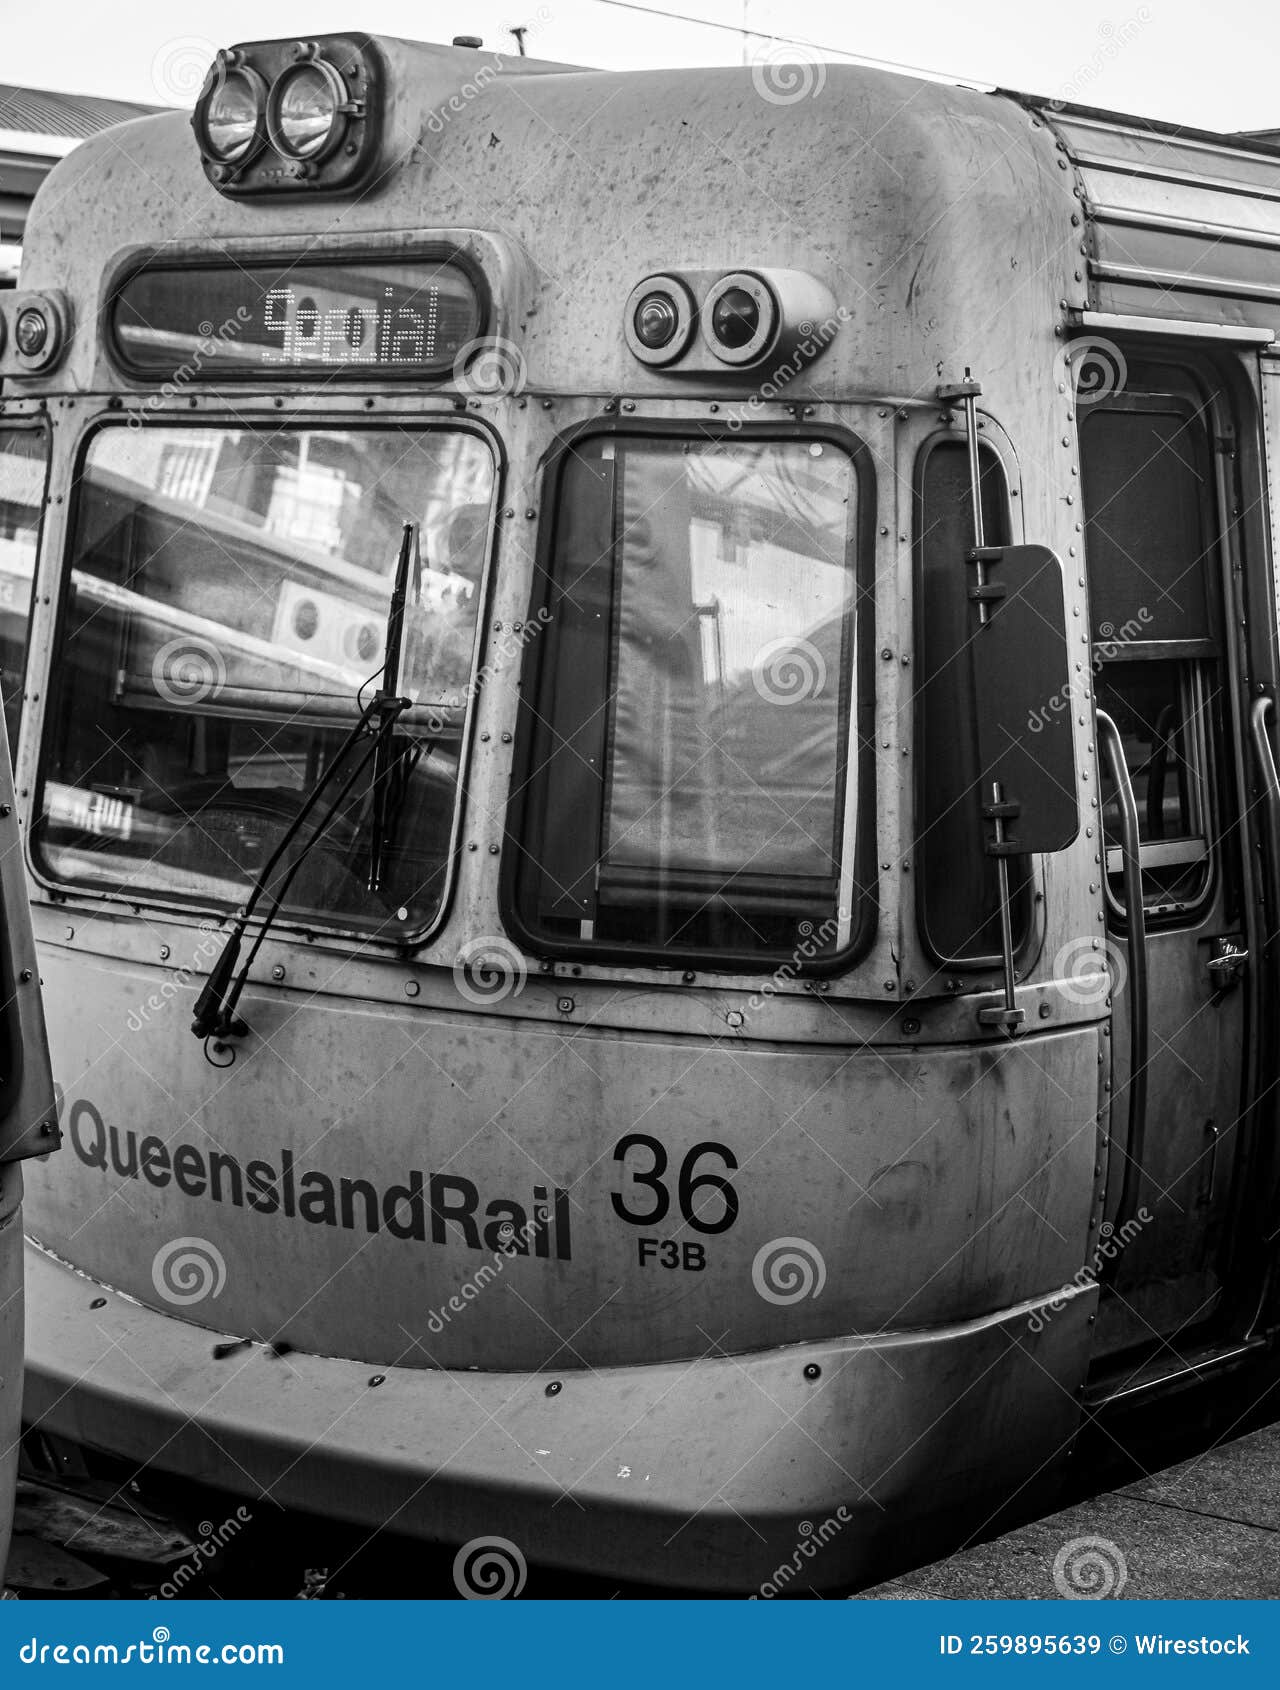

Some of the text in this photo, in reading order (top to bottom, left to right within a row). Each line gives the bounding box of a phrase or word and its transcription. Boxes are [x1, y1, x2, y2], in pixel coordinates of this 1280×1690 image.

[262, 286, 439, 363] Special
[610, 1133, 739, 1235] 36
[637, 1237, 706, 1272] F3B
